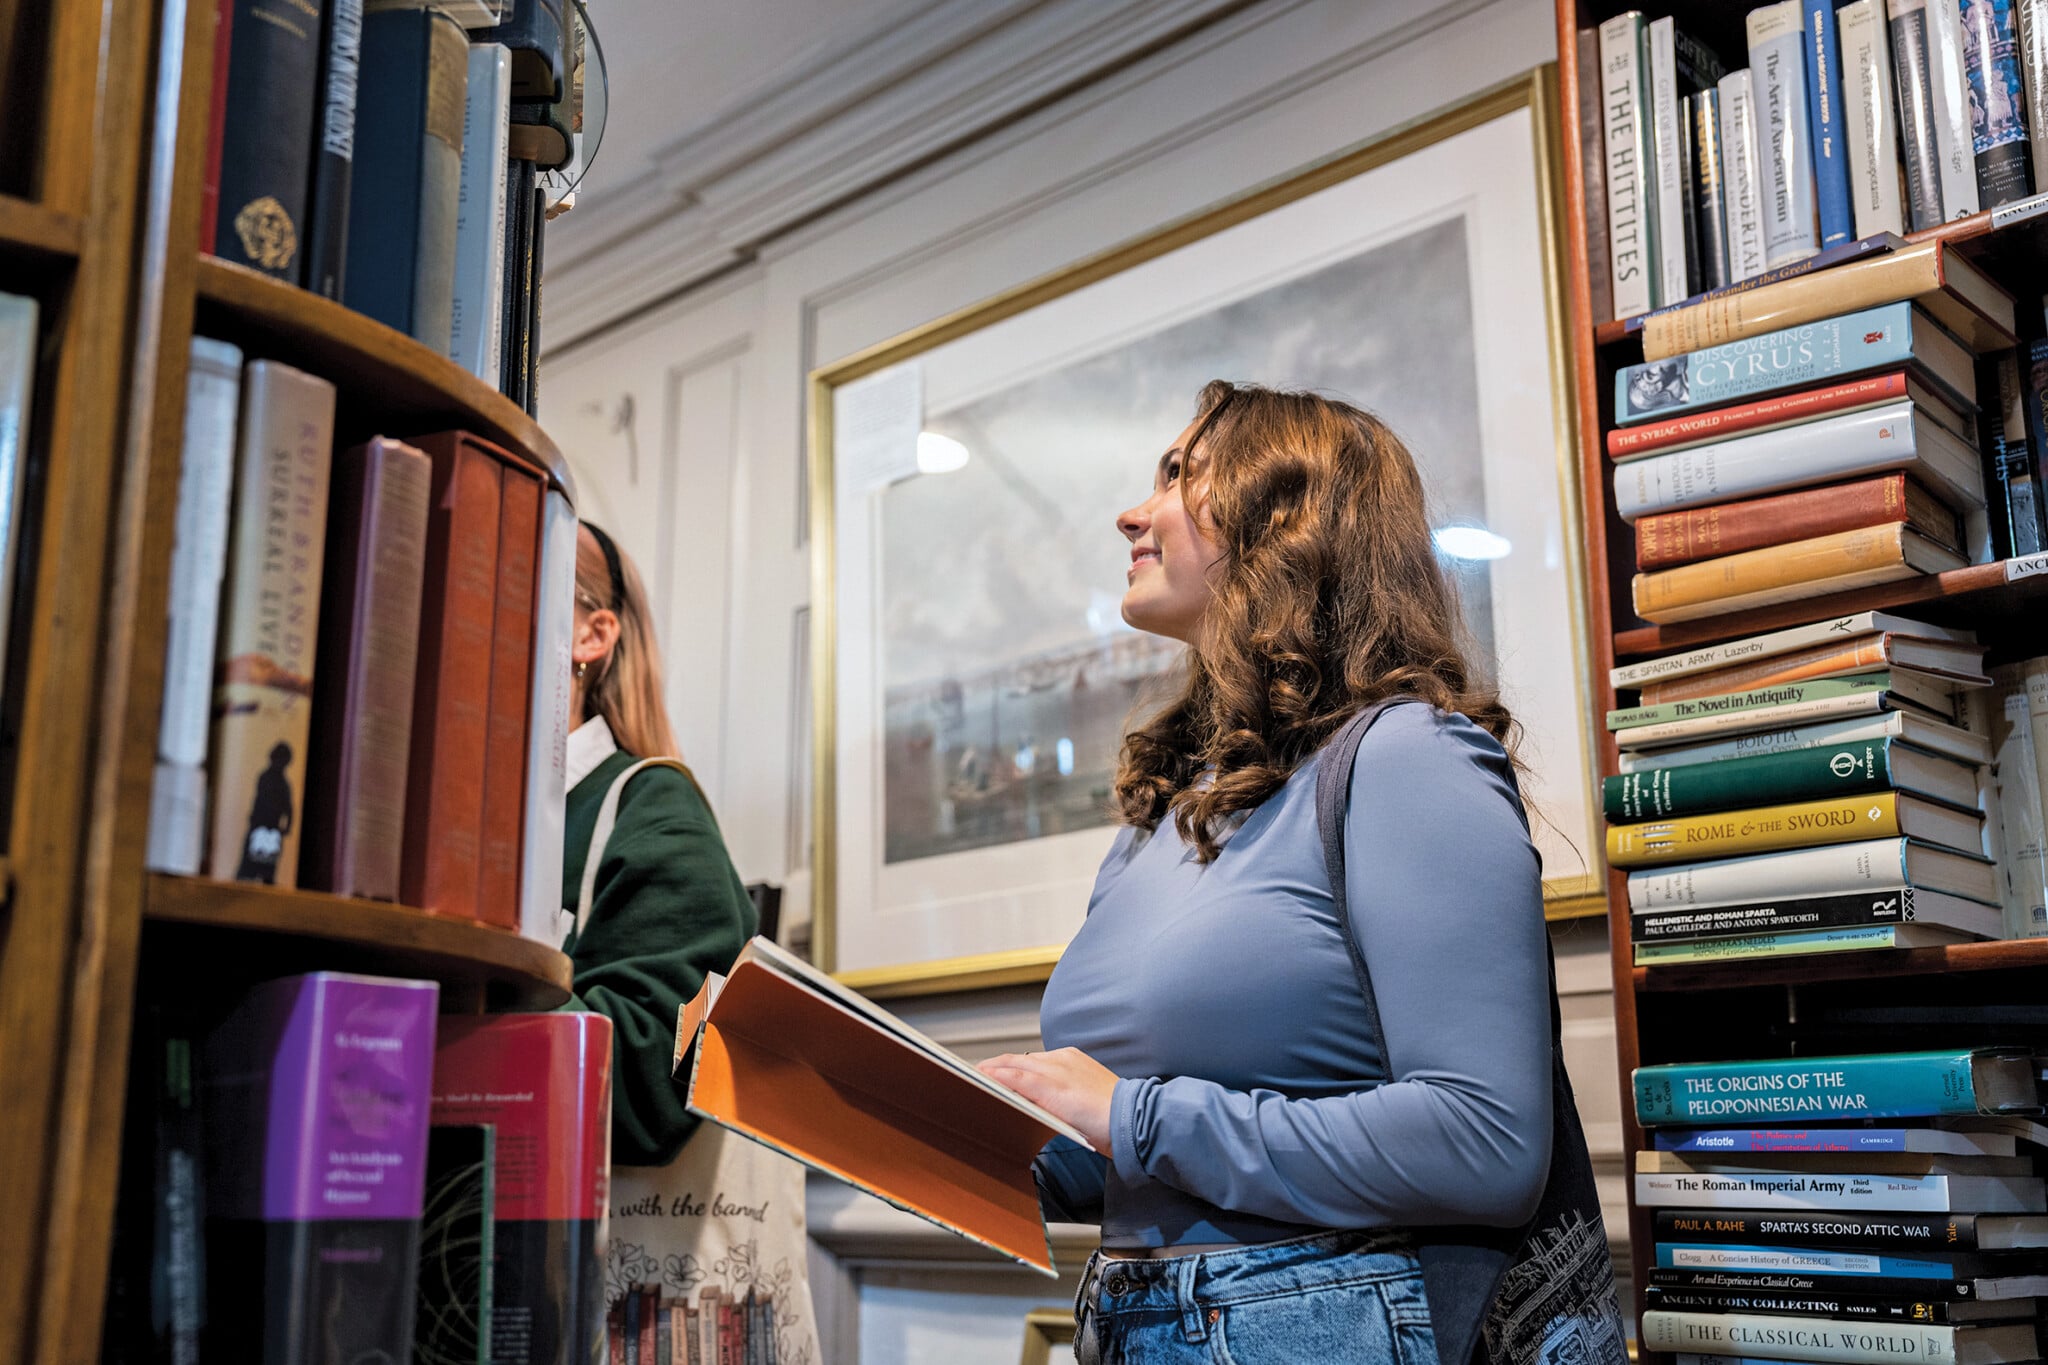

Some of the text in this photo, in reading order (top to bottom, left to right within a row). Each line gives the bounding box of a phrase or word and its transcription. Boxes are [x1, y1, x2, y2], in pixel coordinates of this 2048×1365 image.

[1766, 49, 1788, 222] The Art of Ancient Iran
[1609, 78, 1639, 282] THE HITTITES
[1701, 258, 1814, 304] Alexander the Great
[1694, 325, 1815, 366] DISCOVERING
[1695, 341, 1814, 387] CYRUS
[1786, 370, 1816, 382] WORLD
[1617, 433, 1639, 447] THE
[1640, 425, 1678, 441] SYRIAC
[1680, 416, 1721, 432] WORLD
[261, 449, 294, 574] SURREAL
[1696, 516, 1706, 544] MAU
[1709, 508, 1720, 550] KELSEY
[1618, 642, 1764, 681] THE SPARTAN ARMY Lazenby
[1674, 703, 1696, 717] The
[1698, 697, 1730, 713] Novel
[1731, 695, 1743, 708] in
[1744, 686, 1805, 707] Antiquity
[1866, 745, 1875, 779] Praeger
[1622, 776, 1631, 803] Praeger
[1642, 788, 1650, 798] of
[1686, 808, 1857, 843] ROME & THE SWORD
[1644, 908, 1776, 927] HELLENISTIC AND ROMAN SPARTA
[1644, 912, 1819, 936] PAUL CARTLEDGE AND ANTONY SPAWFORTH
[1684, 1071, 1846, 1094] THE ORIGINS OF THE
[1688, 1094, 1868, 1117] PELOPONNESIAN WAR
[1696, 1135, 1735, 1147] Aristotle
[1860, 1137, 1894, 1145] CAMBRIDGE
[1675, 1178, 1699, 1191] The
[1702, 1179, 1747, 1192] Roman
[1750, 1178, 1806, 1196] Imperial
[1809, 1179, 1846, 1196] Army
[1852, 1178, 1870, 1187] Third
[1850, 1187, 1873, 1195] Edition
[620, 1193, 663, 1218] with
[670, 1193, 706, 1218] the
[711, 1193, 770, 1224] band
[1674, 1219, 1958, 1244] PAUL A. RAHE SPARTA'S SECOND ATTIC WAR Yale
[1679, 1253, 1702, 1264] Clogg
[1709, 1254, 1717, 1263] A
[1717, 1254, 1749, 1264] Concise
[1750, 1254, 1780, 1266] History
[1781, 1255, 1790, 1265] of
[1791, 1256, 1832, 1266] GREECE
[1691, 1273, 1704, 1284] Art
[1704, 1273, 1717, 1285] and
[1718, 1274, 1752, 1287] Experience
[1752, 1276, 1760, 1286] in
[1760, 1275, 1790, 1288] Classical
[1790, 1276, 1814, 1289] Greece
[1660, 1294, 1877, 1314] ANCIENT COIN COLLECTING SAYLES
[1685, 1324, 1916, 1354] THE CLASSICAL WORLD
